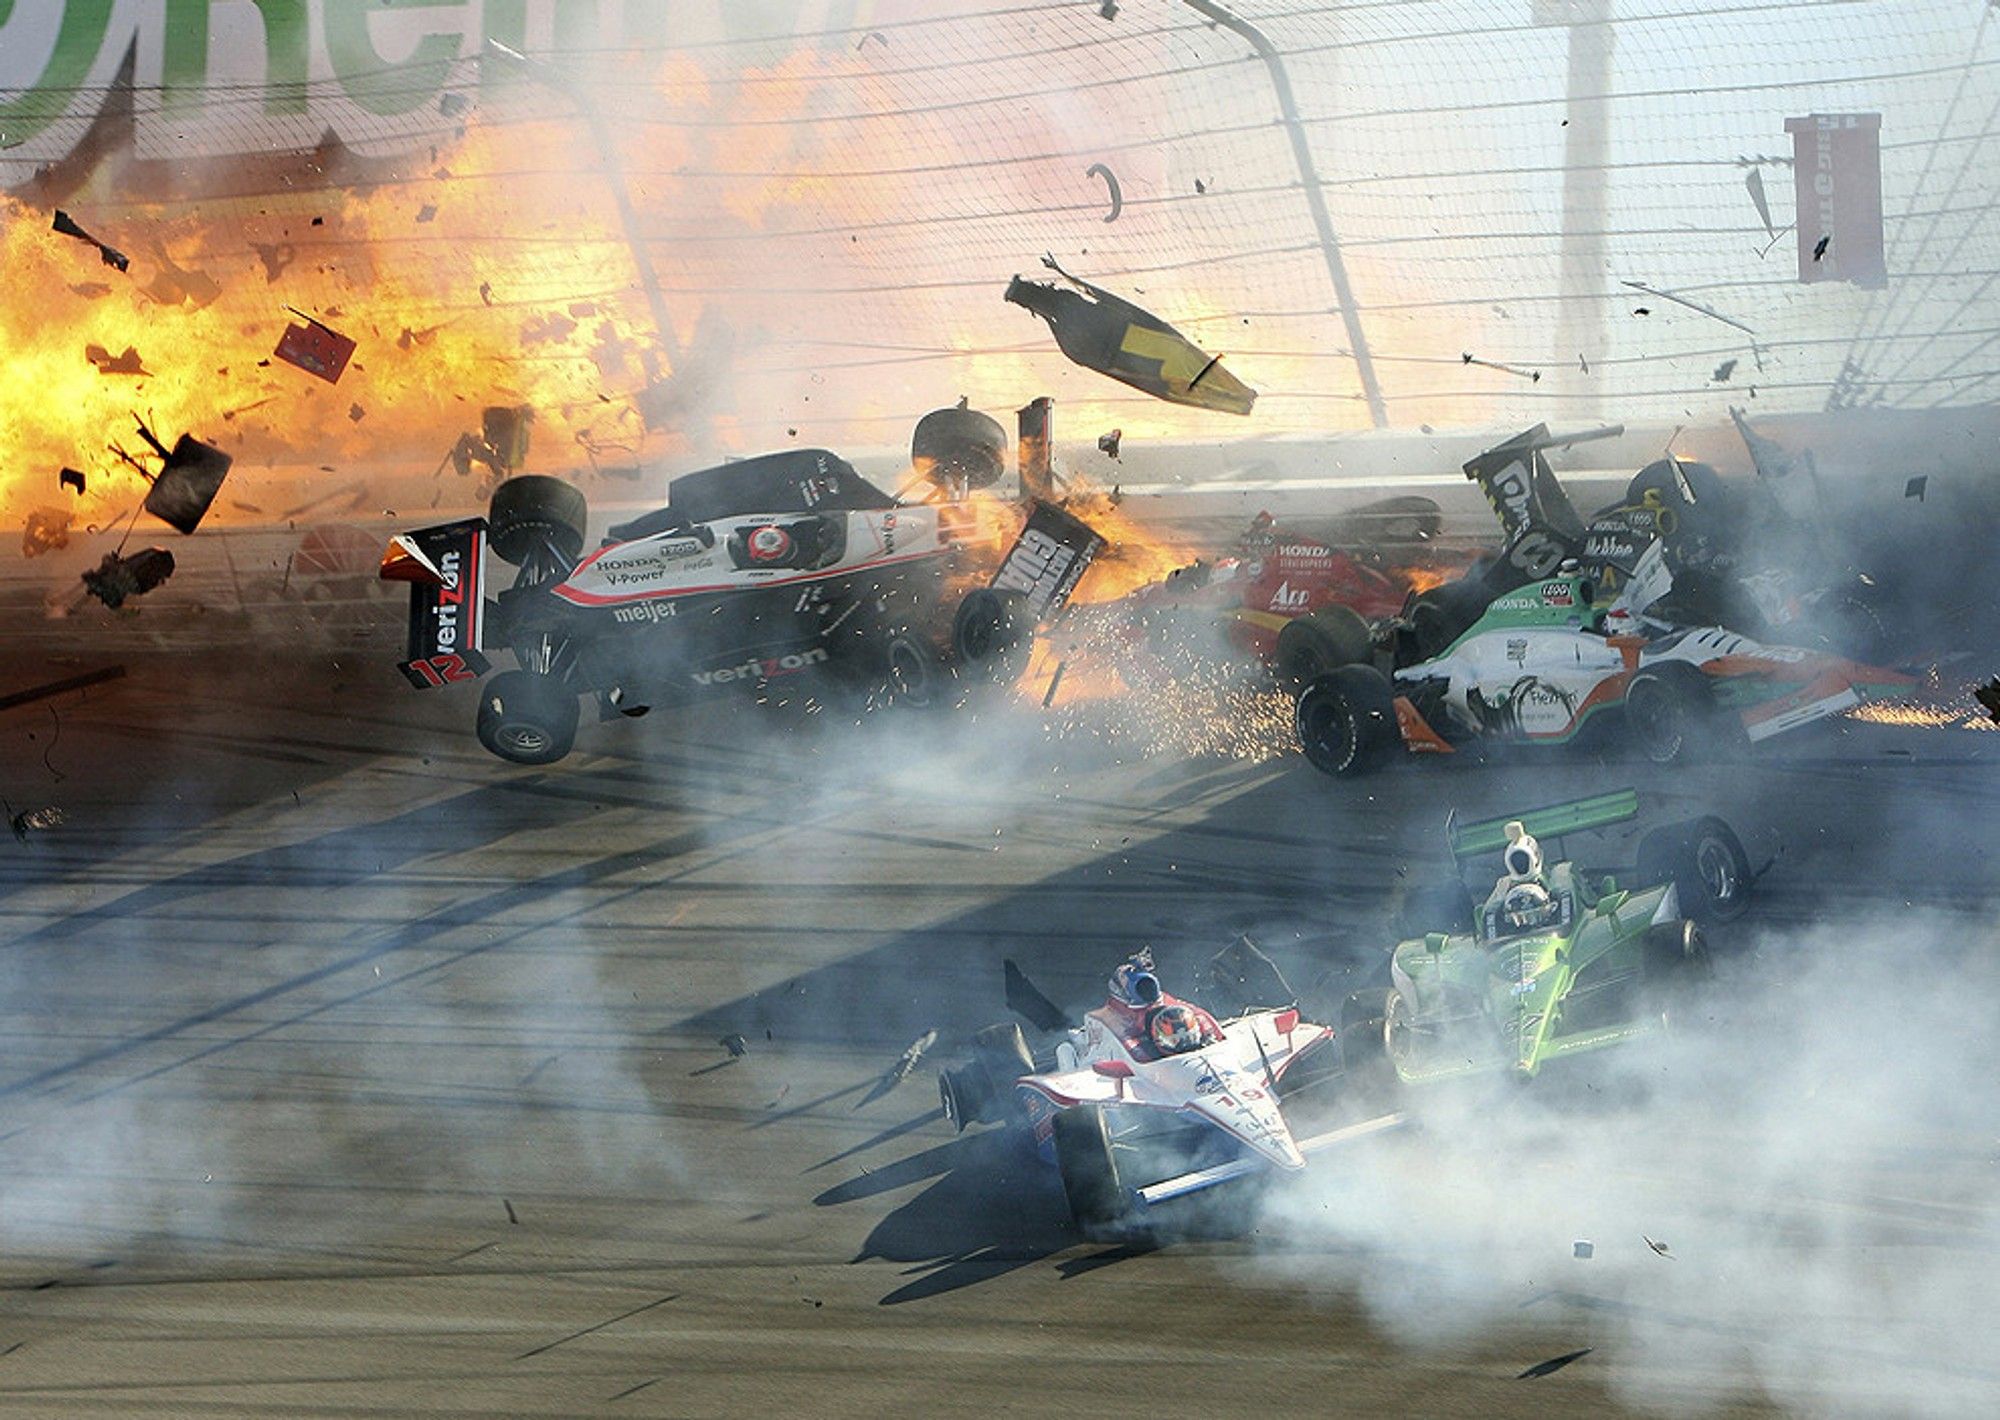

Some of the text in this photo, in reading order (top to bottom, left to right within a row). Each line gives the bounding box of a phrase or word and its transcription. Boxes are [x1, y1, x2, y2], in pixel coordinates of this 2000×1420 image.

[597, 557, 661, 572] HONDA
[607, 570, 665, 586] V-Power
[613, 600, 677, 623] meijer
[1490, 599, 1539, 610] HONDA
[409, 653, 476, 687] 12
[691, 648, 829, 686] verizon
